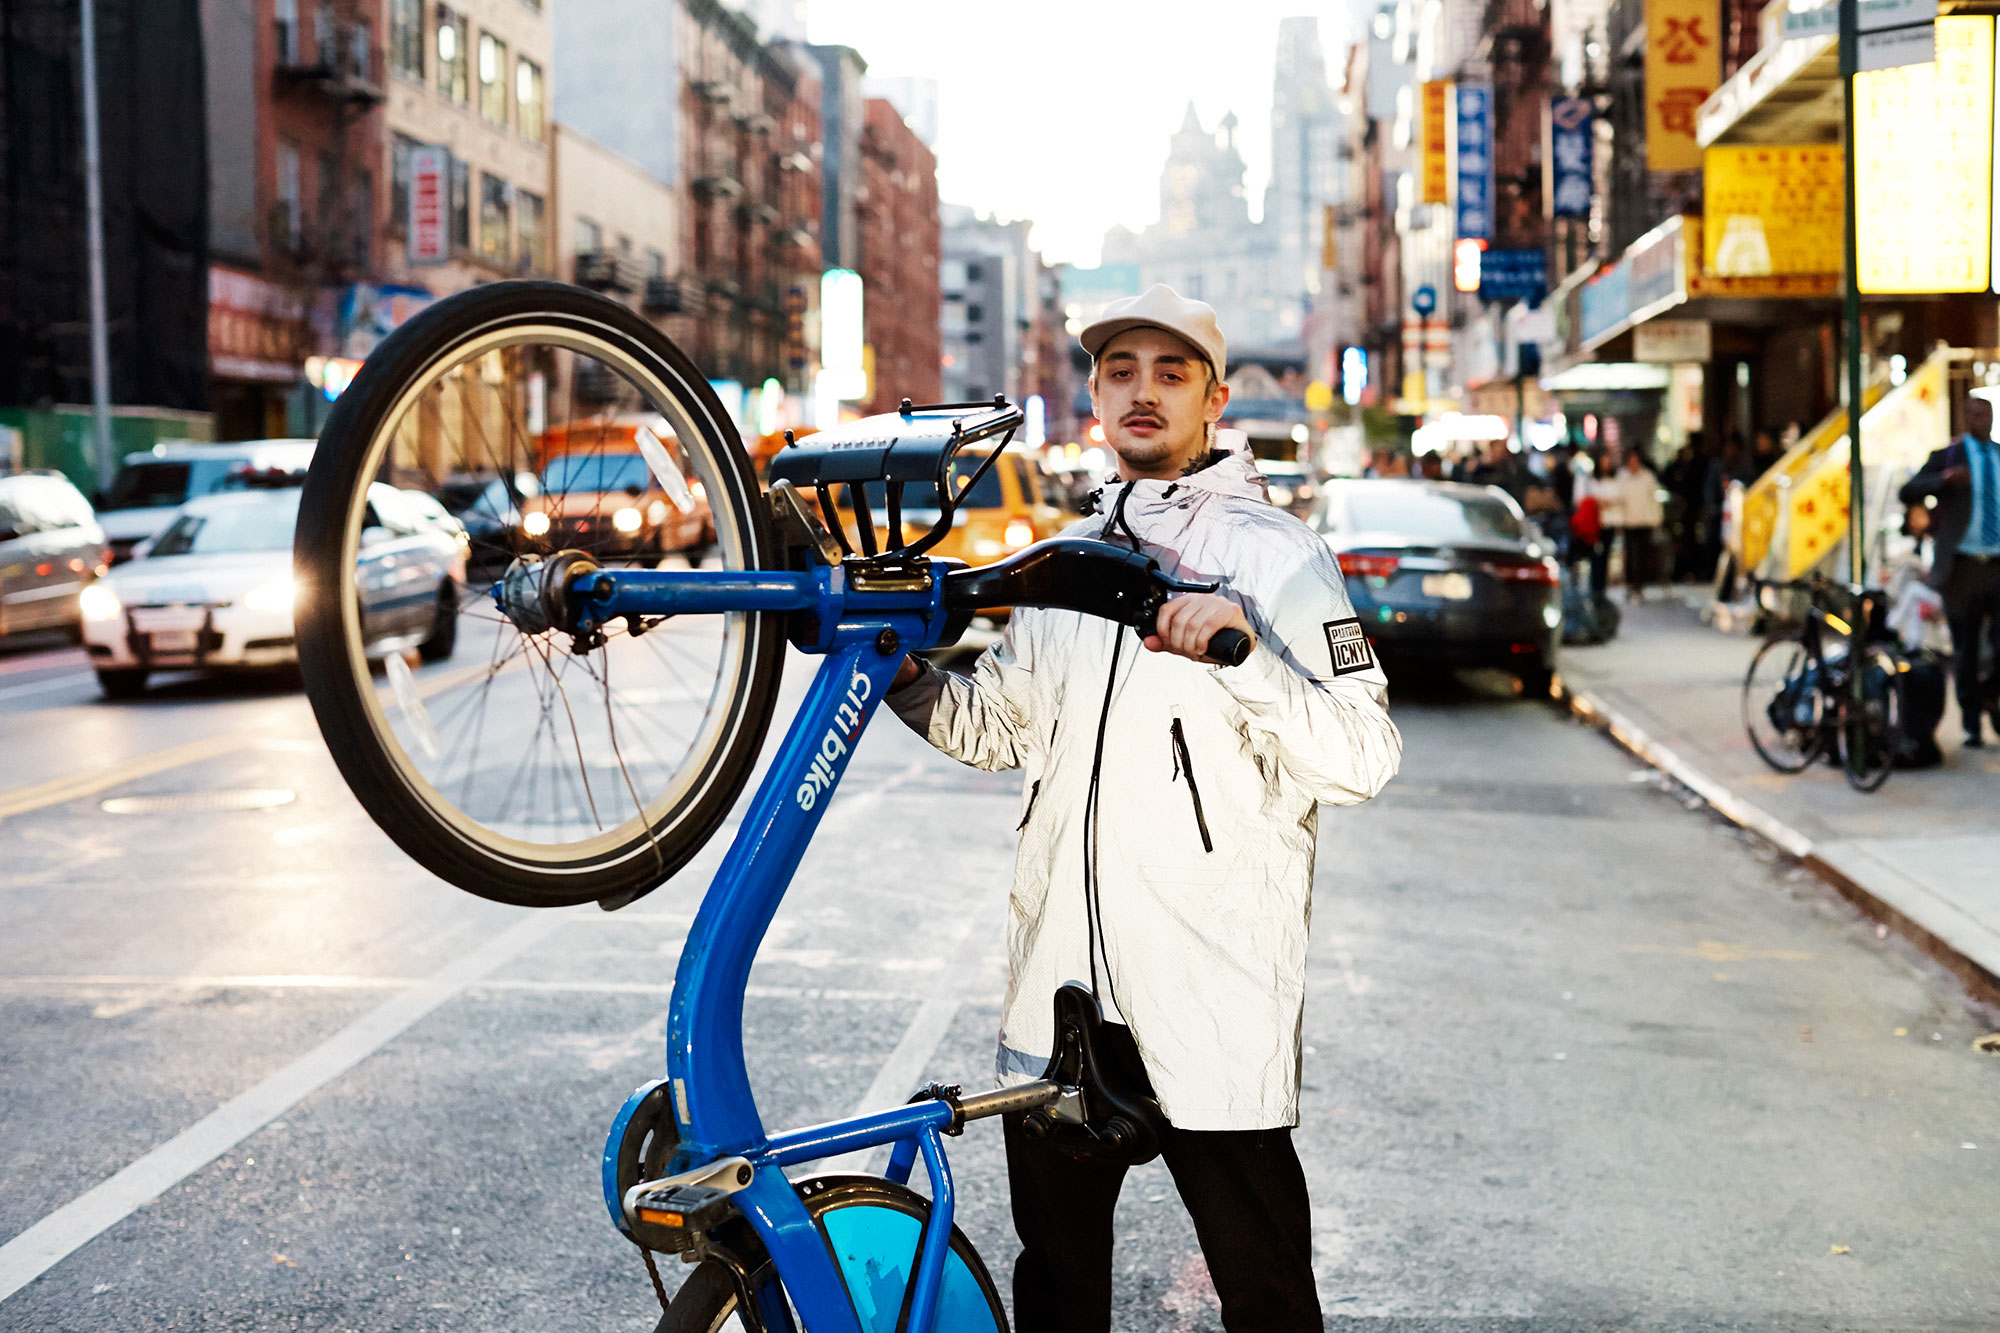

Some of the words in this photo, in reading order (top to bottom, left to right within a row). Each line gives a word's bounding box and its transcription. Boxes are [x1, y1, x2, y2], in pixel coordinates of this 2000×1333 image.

[1656, 16, 1711, 139] 公司
[1331, 626, 1361, 640] PUMA
[1335, 641, 1366, 666] ICNY
[797, 728, 847, 811] bike
